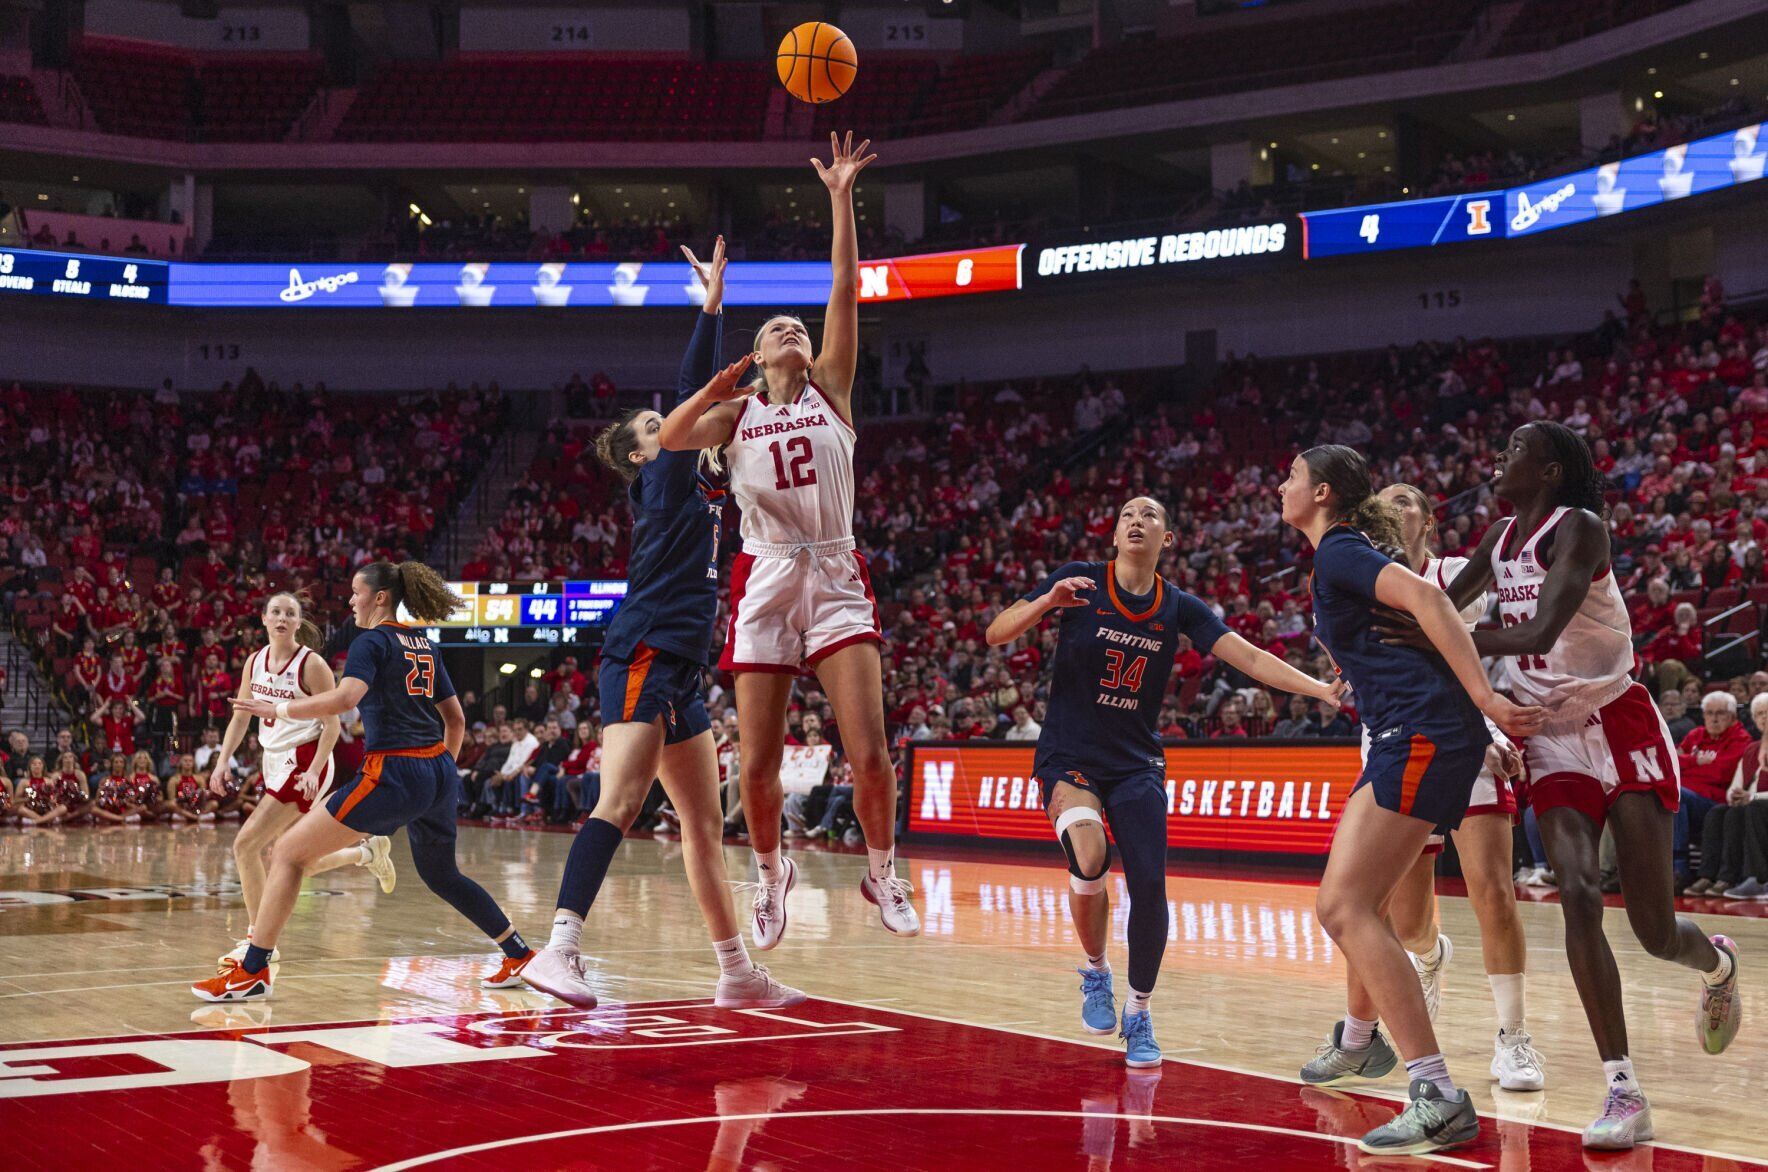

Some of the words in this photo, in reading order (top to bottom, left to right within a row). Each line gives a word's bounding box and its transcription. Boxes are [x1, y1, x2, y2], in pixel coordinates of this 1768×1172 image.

[223, 26, 260, 41] 213
[551, 26, 589, 41] 214
[887, 25, 925, 40] 215
[1360, 214, 1379, 243] 4
[1038, 237, 1157, 276] OFFENSIVE
[1159, 223, 1287, 264] REBOUNDS
[280, 268, 359, 302] Amigos
[860, 266, 889, 297] N
[1419, 290, 1460, 309] 115
[199, 344, 240, 360] 113
[741, 413, 829, 442] NEBRASKA
[769, 436, 817, 490] 12
[528, 599, 557, 621] 44
[396, 632, 431, 650] WALLACE
[1096, 627, 1163, 652] FIGHTING
[404, 651, 435, 698] 23
[1100, 648, 1148, 693] 34
[1096, 693, 1139, 710] ILLINI
[1629, 746, 1665, 782] N
[920, 761, 955, 821] N
